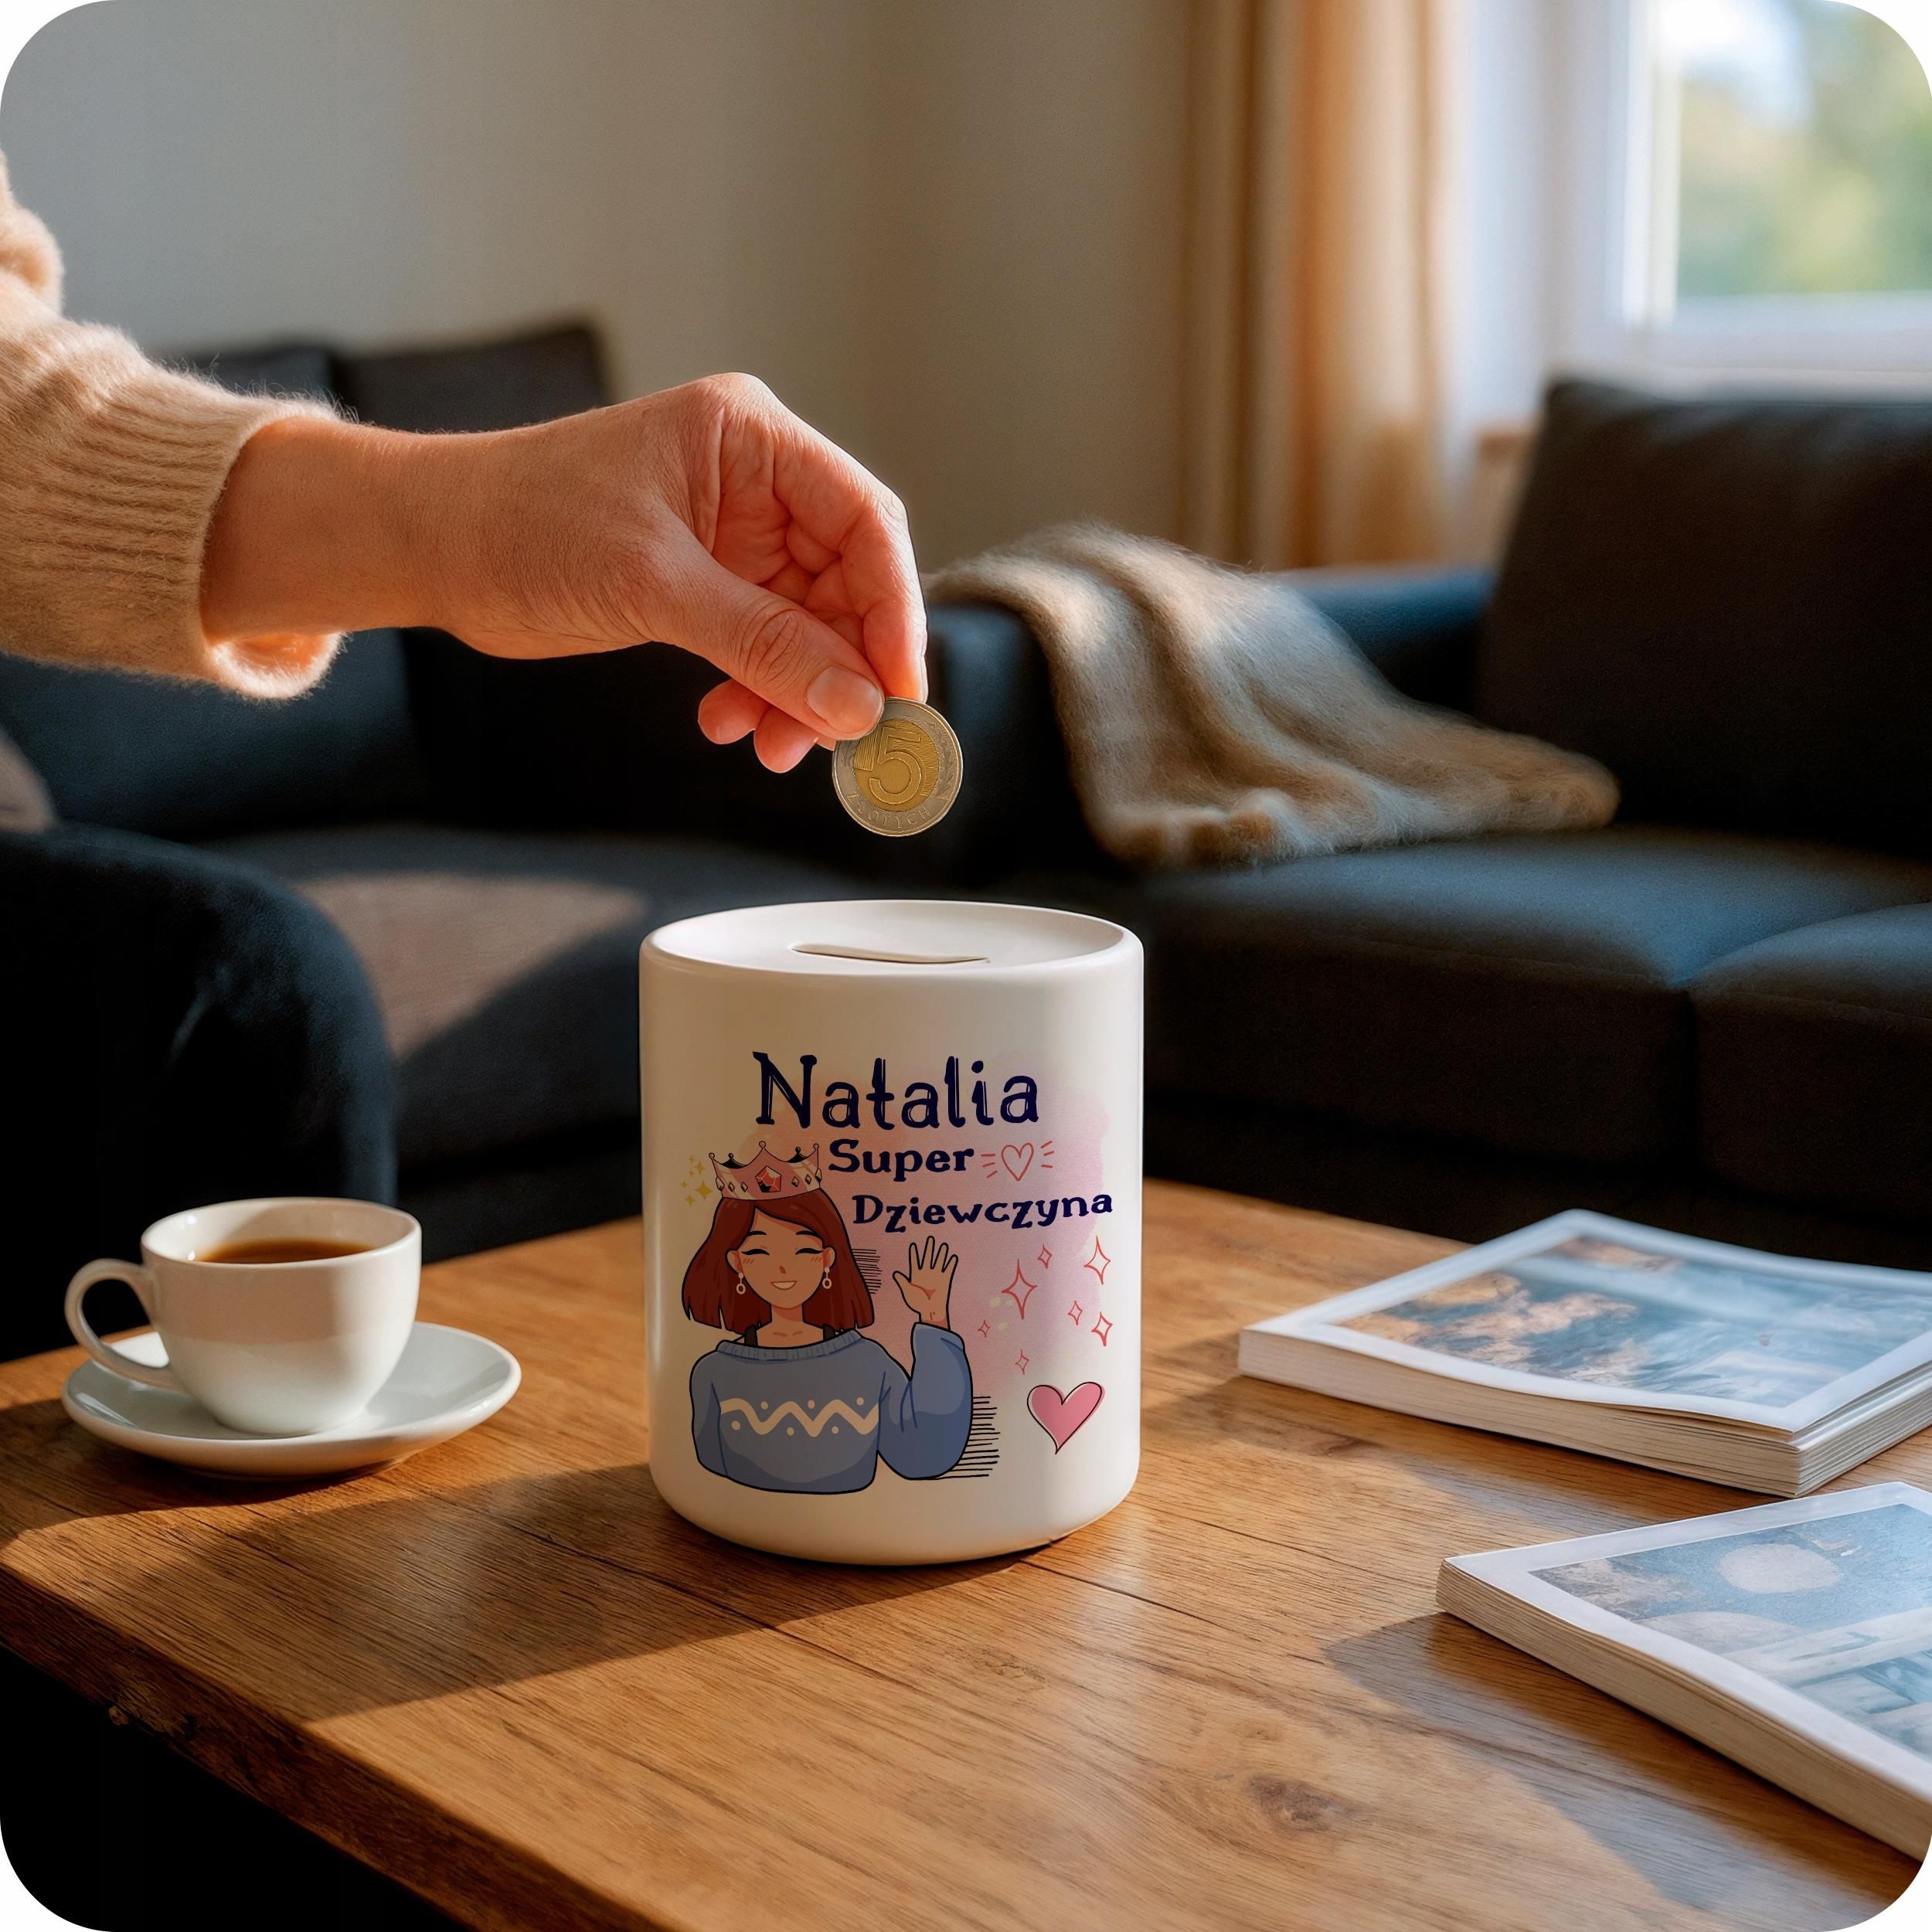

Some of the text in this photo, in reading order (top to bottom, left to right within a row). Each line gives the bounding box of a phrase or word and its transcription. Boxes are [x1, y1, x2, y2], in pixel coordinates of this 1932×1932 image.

[868, 726, 922, 805] 5
[752, 1051, 1039, 1131] Natalia
[828, 1138, 975, 1182] Super
[852, 1194, 1113, 1233] Dziewczyna
